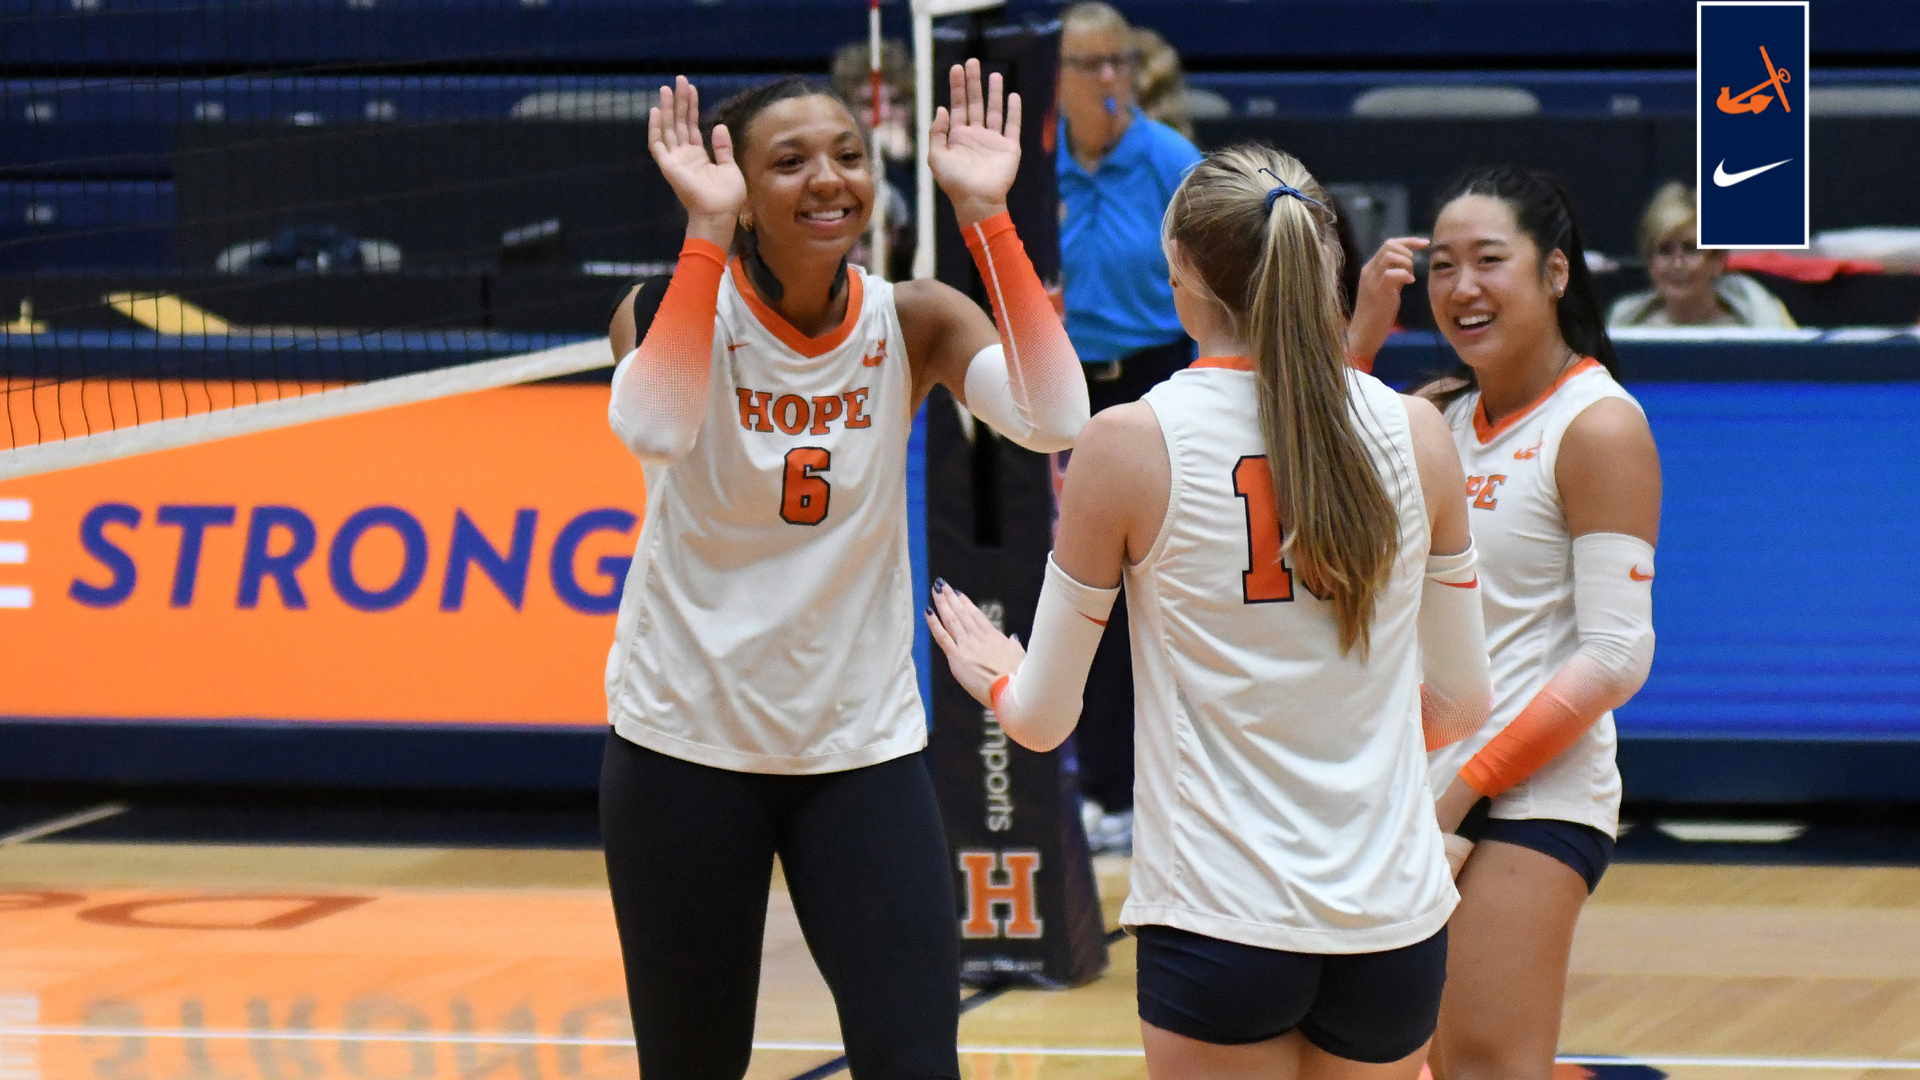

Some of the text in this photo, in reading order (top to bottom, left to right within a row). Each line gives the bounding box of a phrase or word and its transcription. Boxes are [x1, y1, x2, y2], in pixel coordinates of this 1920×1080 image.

[736, 387, 872, 436] HOPE
[779, 446, 831, 526] 6
[1466, 474, 1507, 511] PE
[68, 502, 640, 615] STRONG
[959, 852, 1043, 938] H
